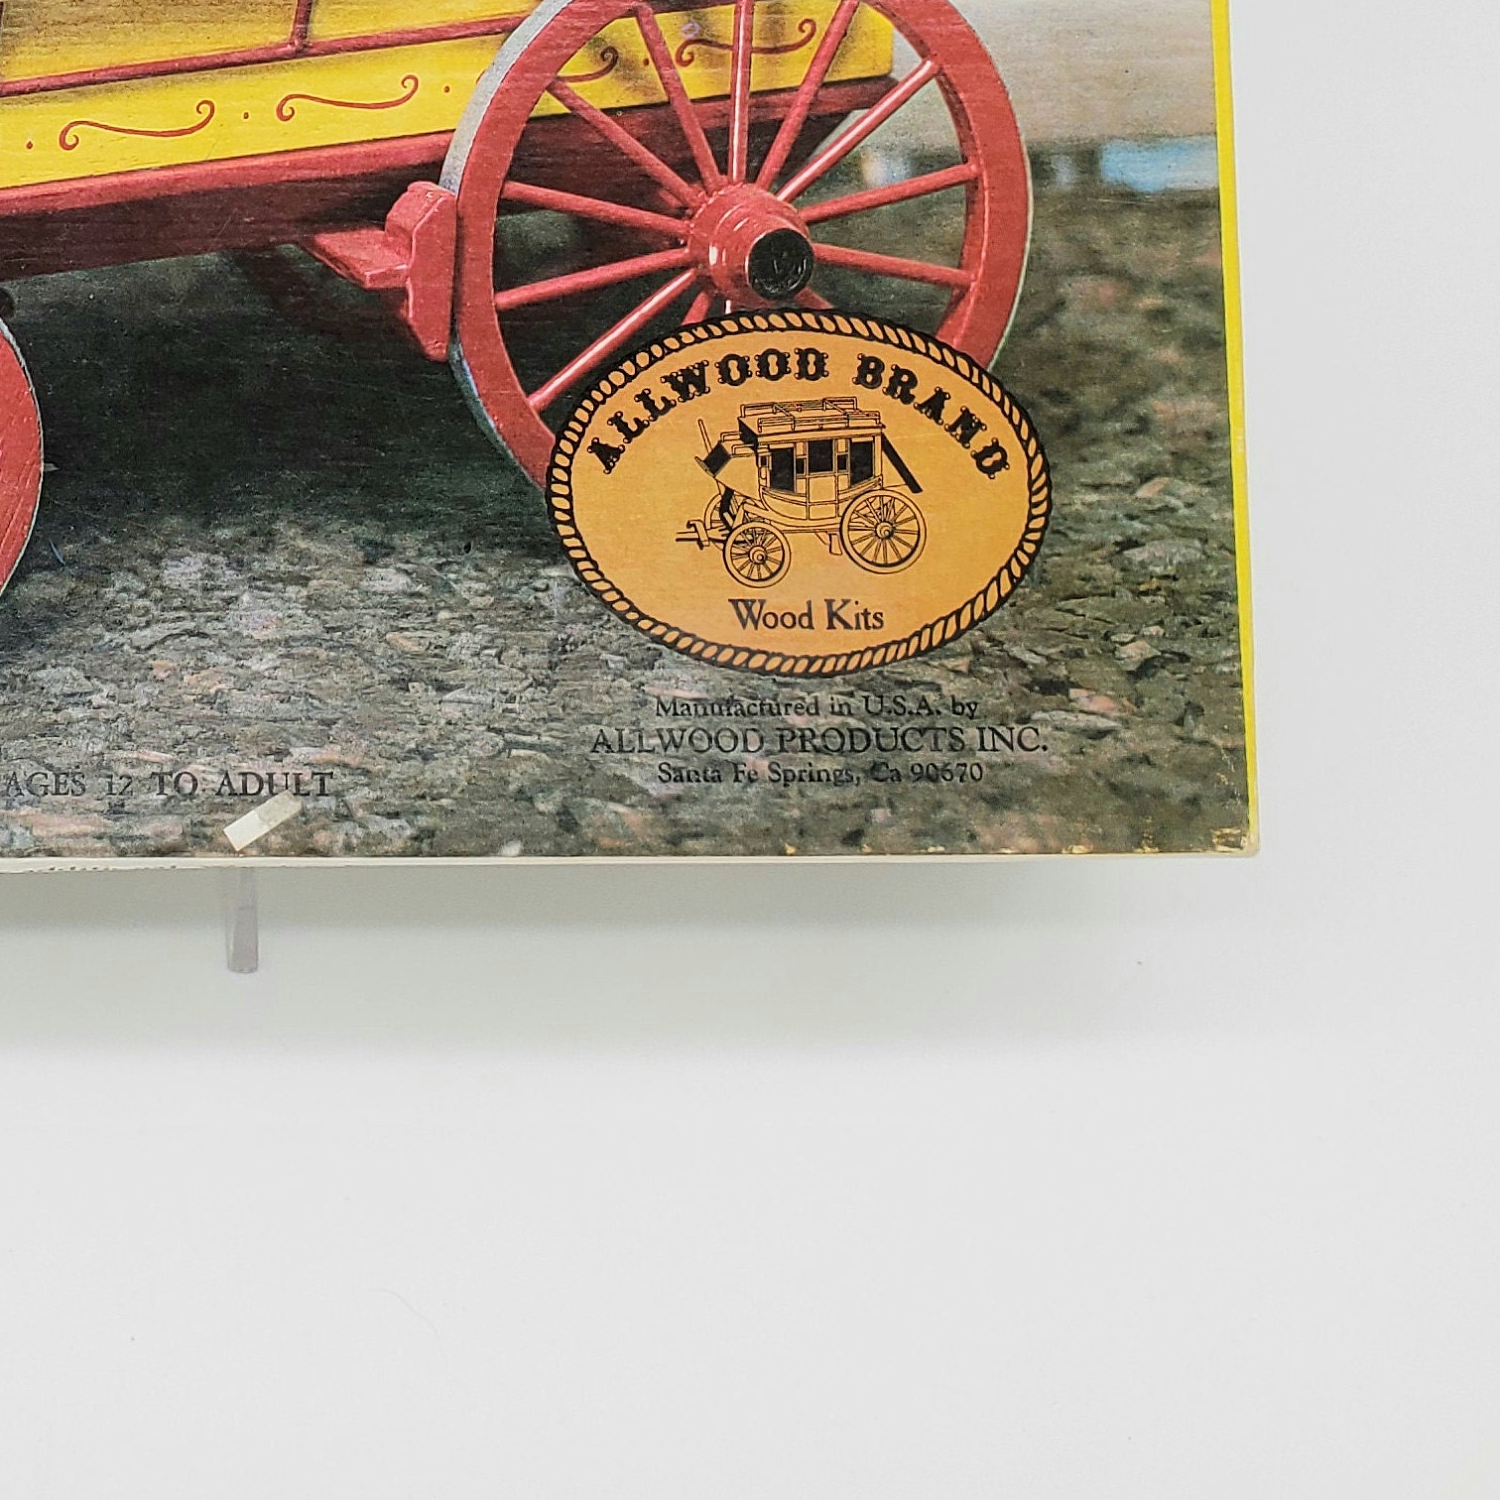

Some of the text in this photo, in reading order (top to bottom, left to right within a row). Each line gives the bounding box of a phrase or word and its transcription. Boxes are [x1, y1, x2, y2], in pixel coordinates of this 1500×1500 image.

[587, 347, 1011, 479] ALLWOOD BRAND
[728, 598, 885, 631] Wood Kits
[656, 694, 978, 720] Manufactured in U.S.A. by
[590, 725, 1048, 754] ALLWOOD PRODUCTS INC.
[5, 771, 86, 796] AGES
[106, 773, 135, 797] 12
[150, 770, 198, 797] TO
[214, 770, 336, 798] ADULT
[657, 761, 984, 787] Santa Fe Springs, Ca 90670
